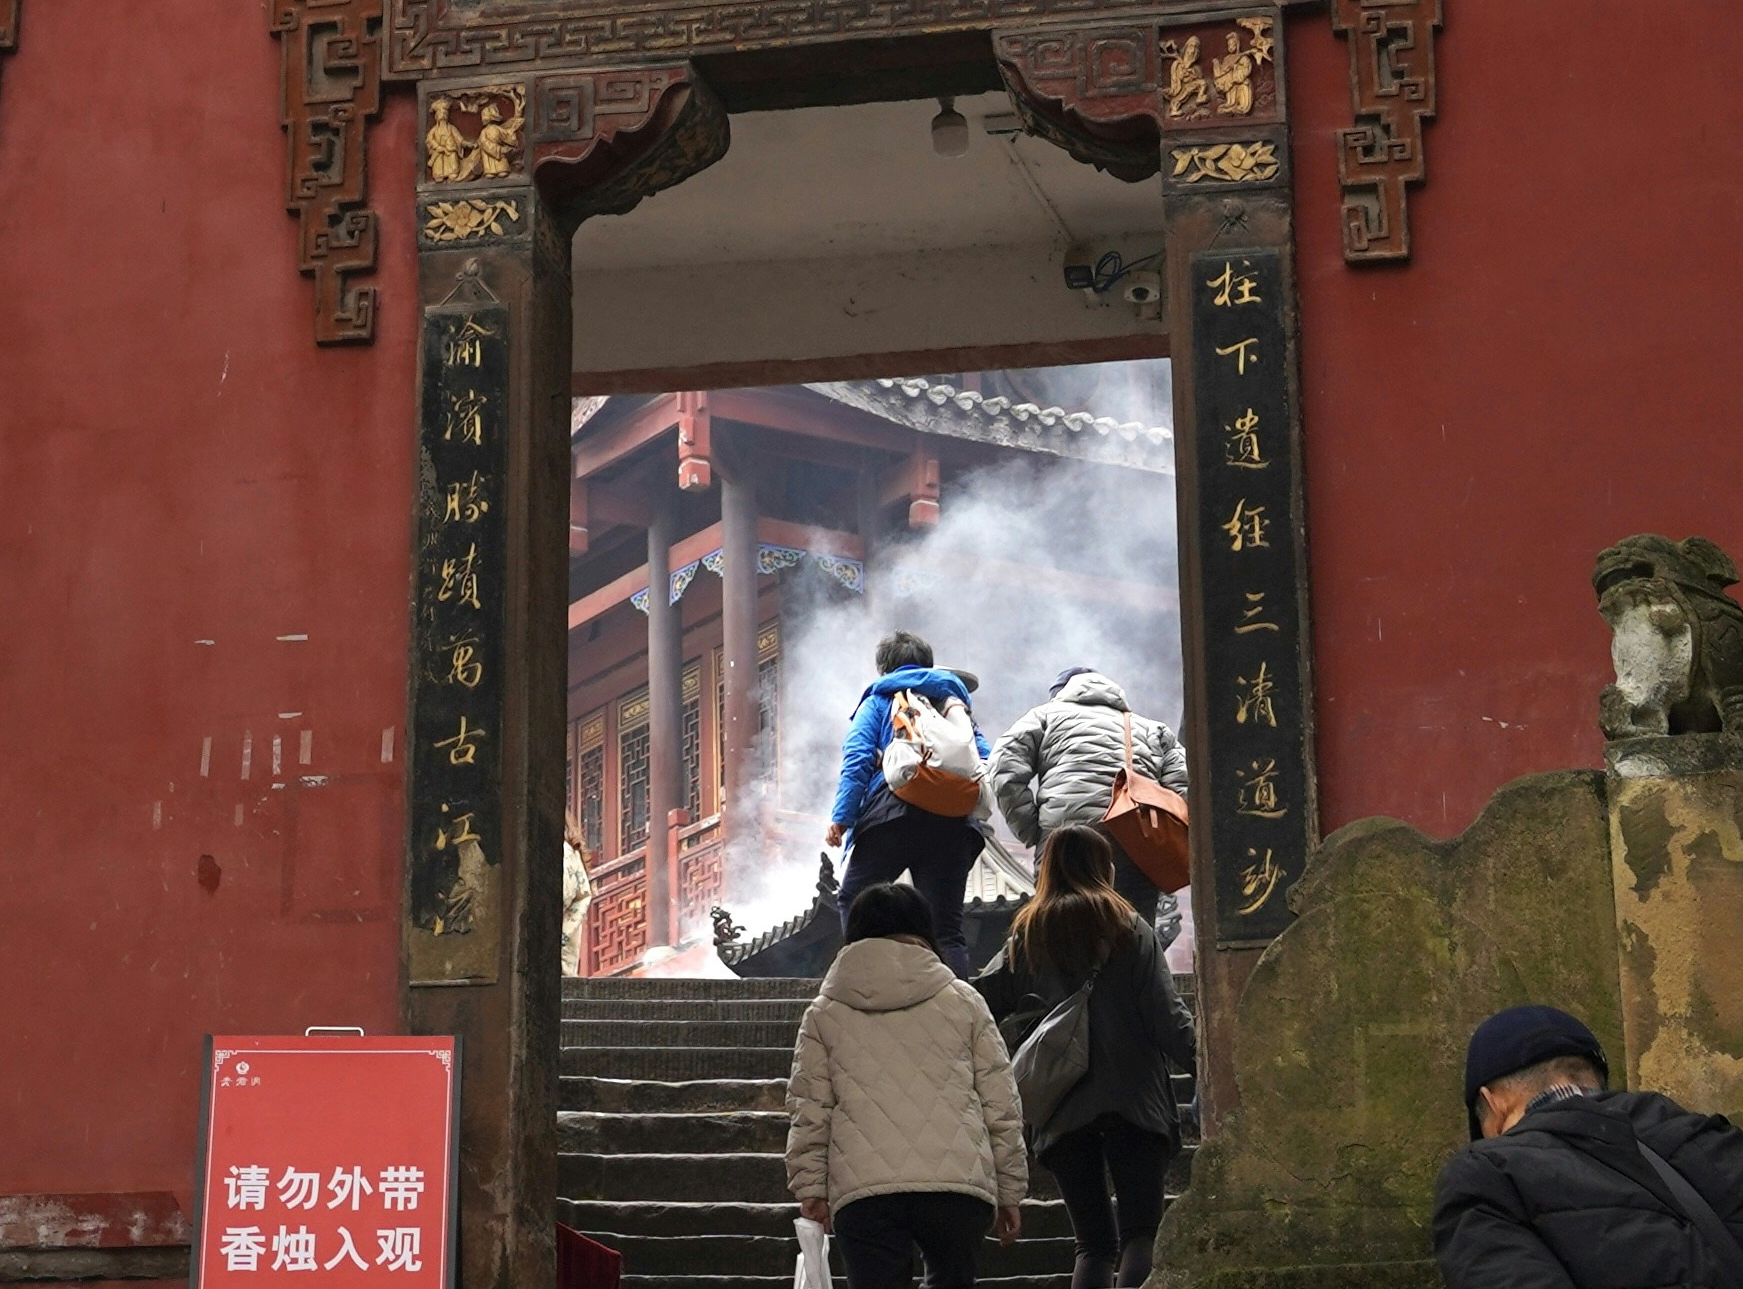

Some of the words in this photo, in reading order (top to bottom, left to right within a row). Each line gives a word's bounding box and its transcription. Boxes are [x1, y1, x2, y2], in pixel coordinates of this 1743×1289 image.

[224, 1165, 425, 1211] 请勿外带
[220, 1225, 423, 1272] 香烛入观
